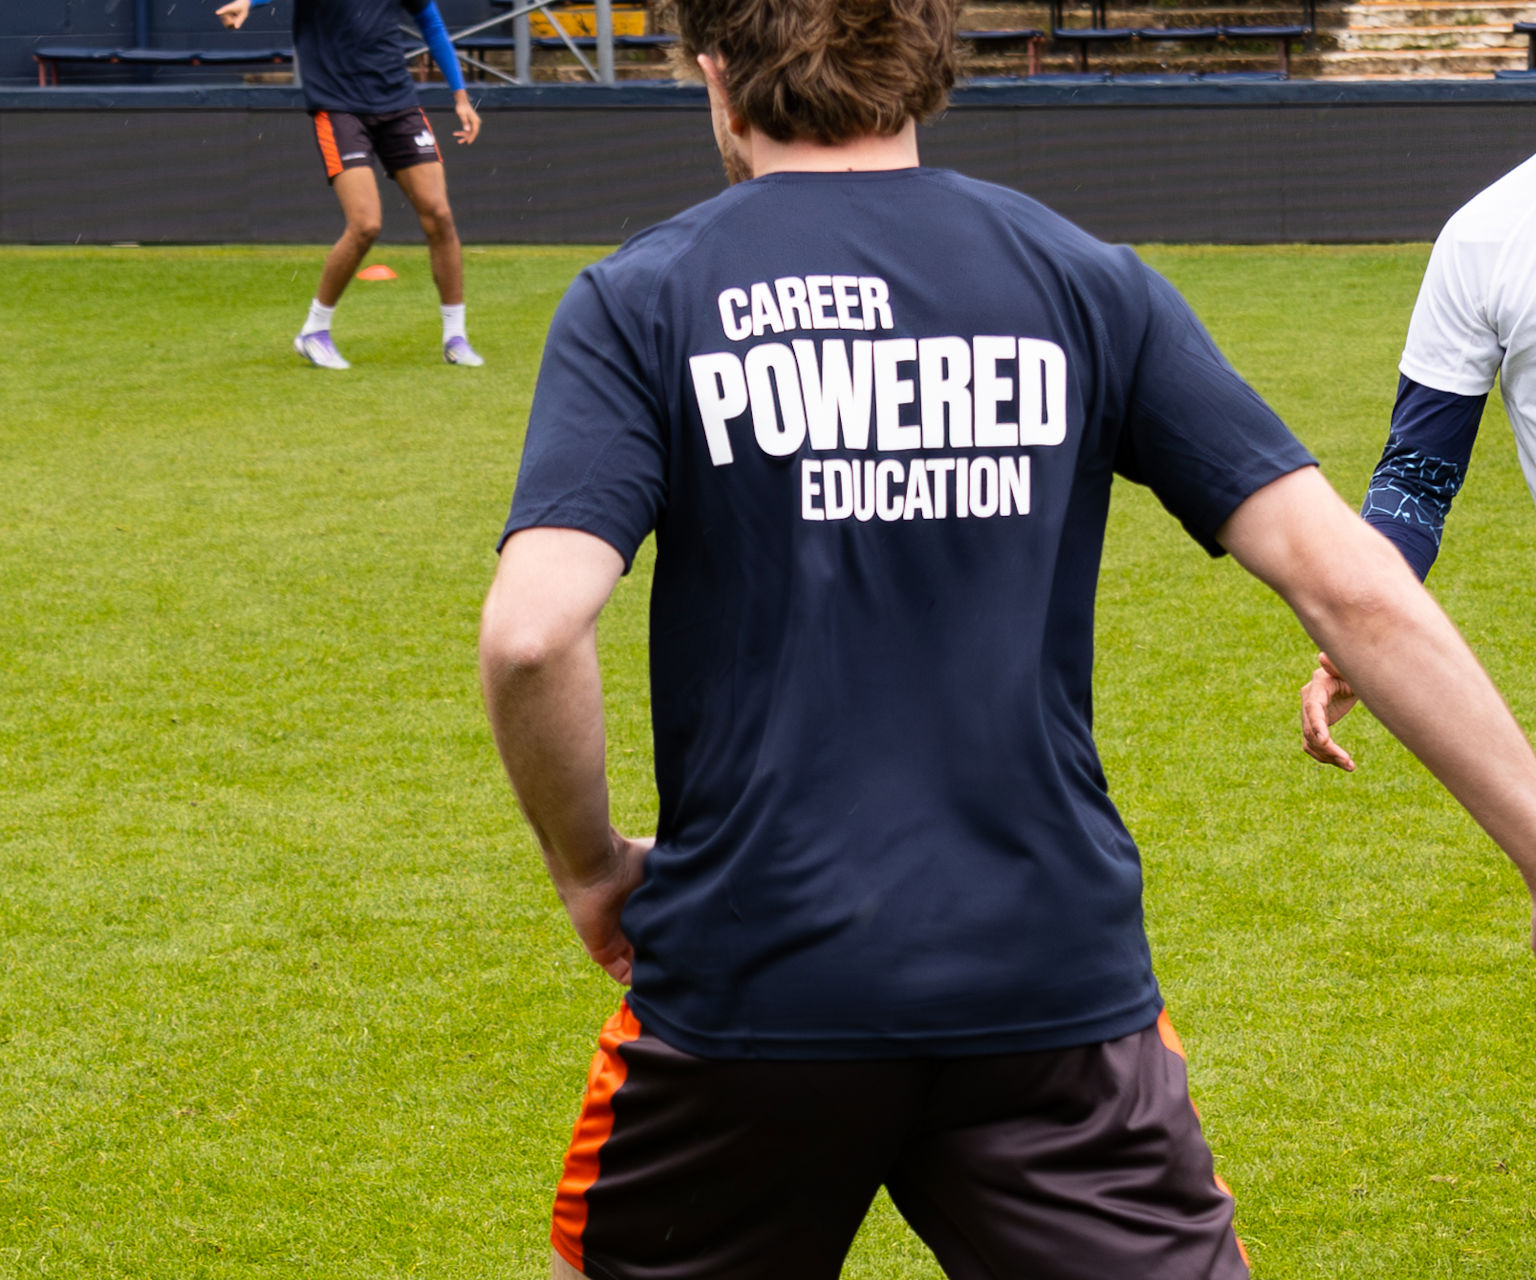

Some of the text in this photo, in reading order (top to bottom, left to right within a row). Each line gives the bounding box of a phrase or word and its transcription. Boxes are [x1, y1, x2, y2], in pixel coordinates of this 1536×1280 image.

[717, 274, 895, 342] CAREER
[688, 335, 1068, 468] POWERED
[801, 455, 1031, 523] EDUCATION
